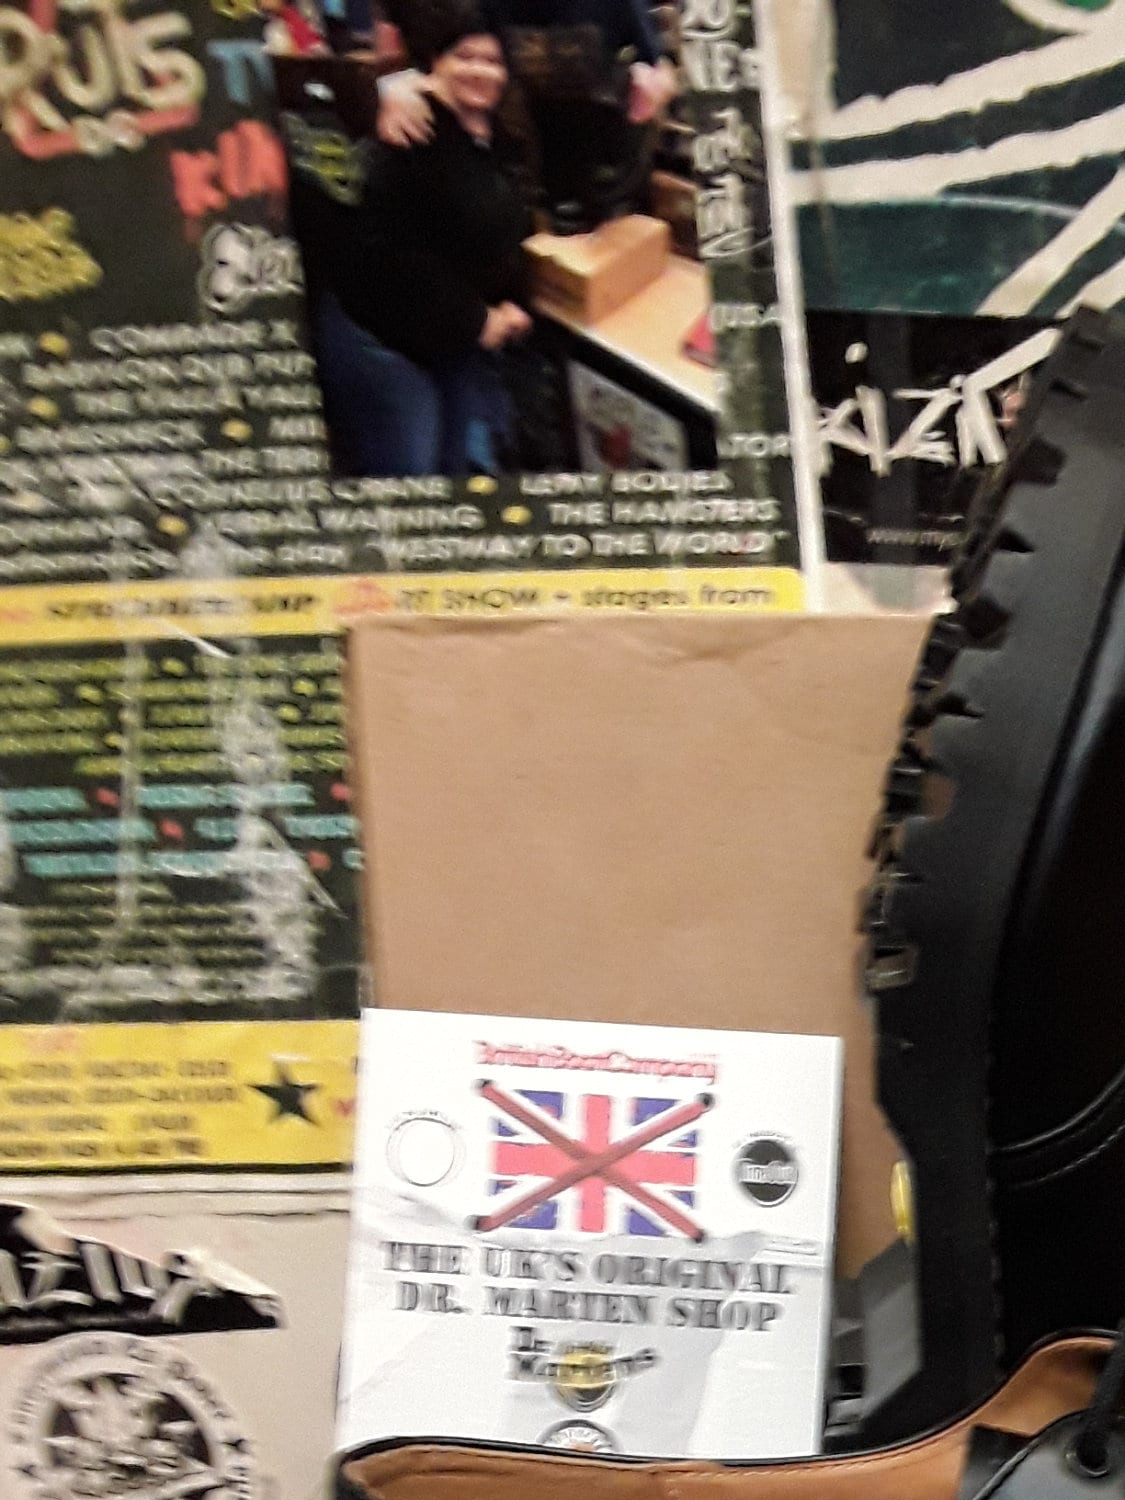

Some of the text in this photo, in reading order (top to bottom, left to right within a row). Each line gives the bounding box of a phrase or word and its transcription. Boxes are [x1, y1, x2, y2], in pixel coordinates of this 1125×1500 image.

[384, 1242, 791, 1294] THE UK'S ORIGINAL
[396, 1281, 780, 1332] DR. MARTEN SHOP
